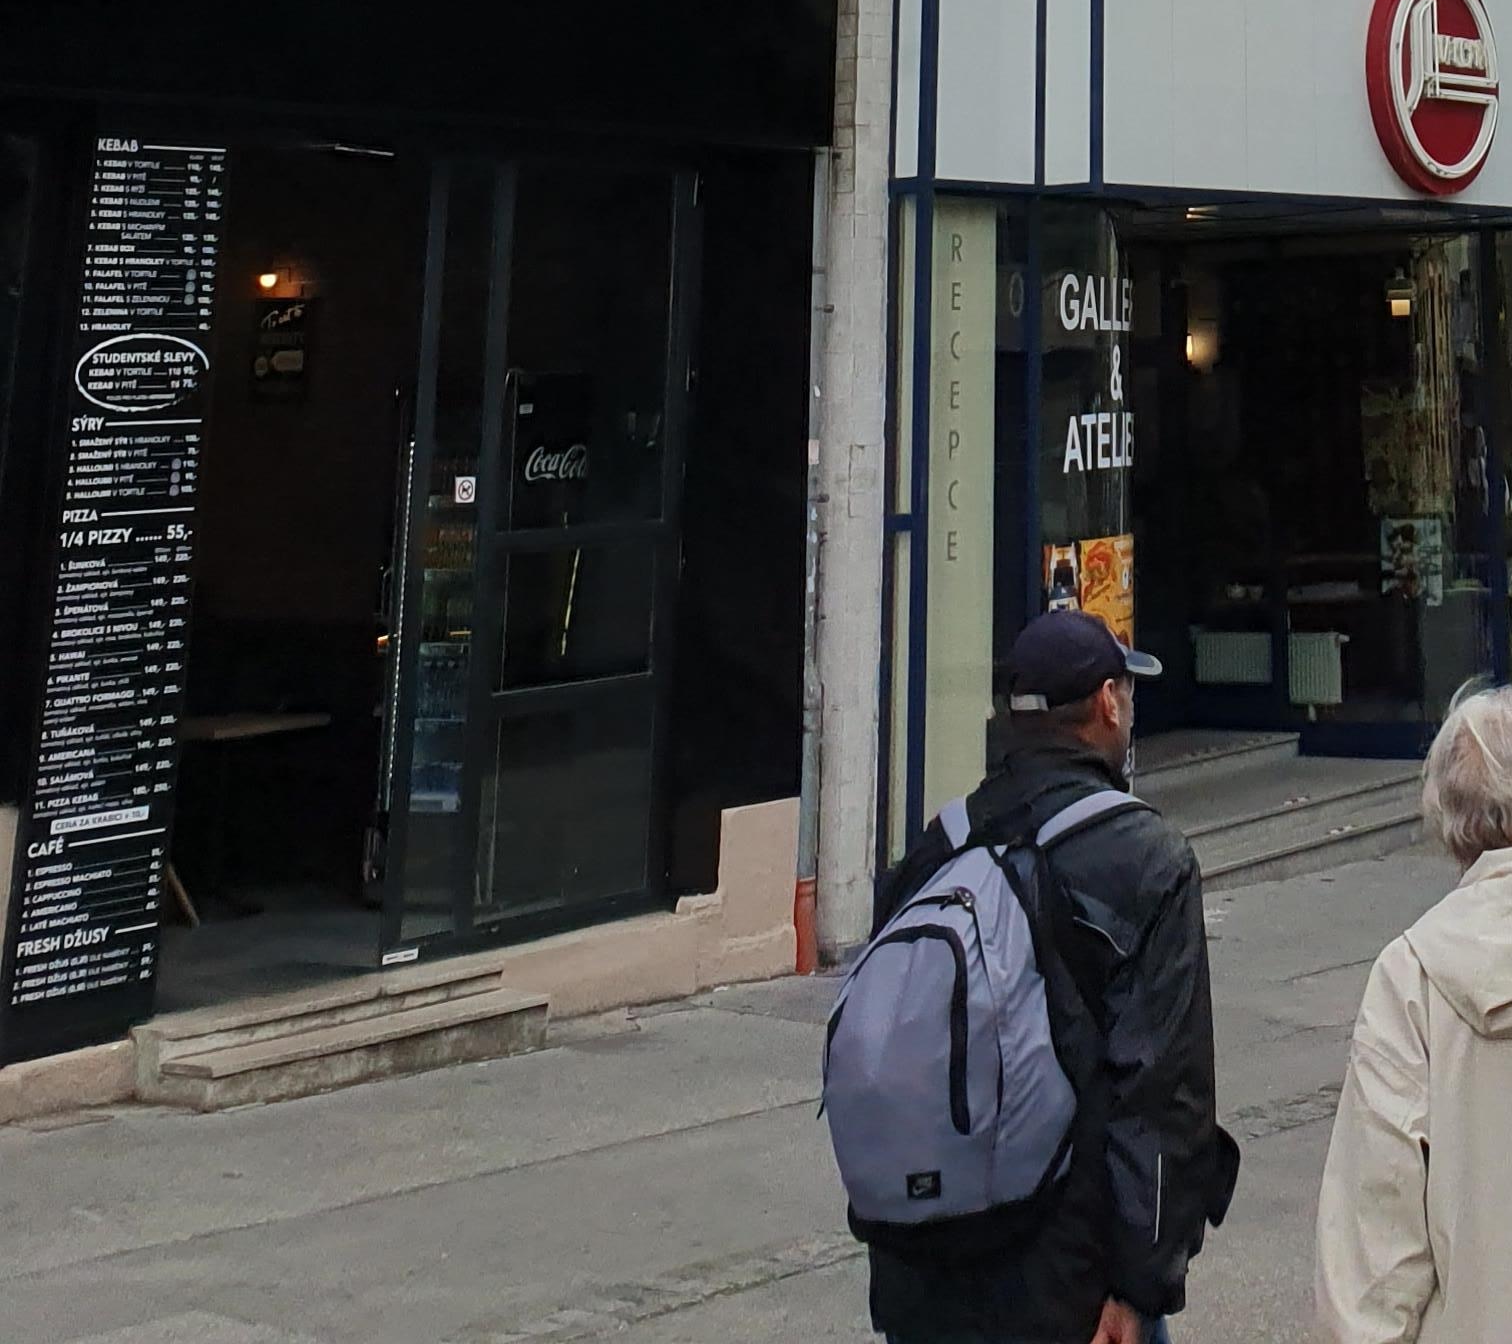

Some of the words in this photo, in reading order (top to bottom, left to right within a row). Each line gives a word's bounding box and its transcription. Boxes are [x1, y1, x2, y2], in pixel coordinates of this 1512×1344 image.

[98, 139, 138, 152] KEBAB
[1060, 273, 1133, 331] GALLE
[92, 350, 161, 364] STUDENTSKÉ
[164, 352, 195, 362] SLEVY
[1110, 344, 1124, 403] &
[946, 233, 963, 563] RECEPCE
[72, 415, 104, 432] SÝRY
[1063, 412, 1134, 474] ATELIE
[63, 509, 98, 523] PIZZA
[60, 531, 83, 548] 1/4
[88, 528, 133, 545] PIZZY
[167, 524, 193, 540] 55,-
[28, 836, 64, 858] CAFÉ
[17, 936, 61, 958] FRESH
[64, 926, 110, 949] DŽUSY
